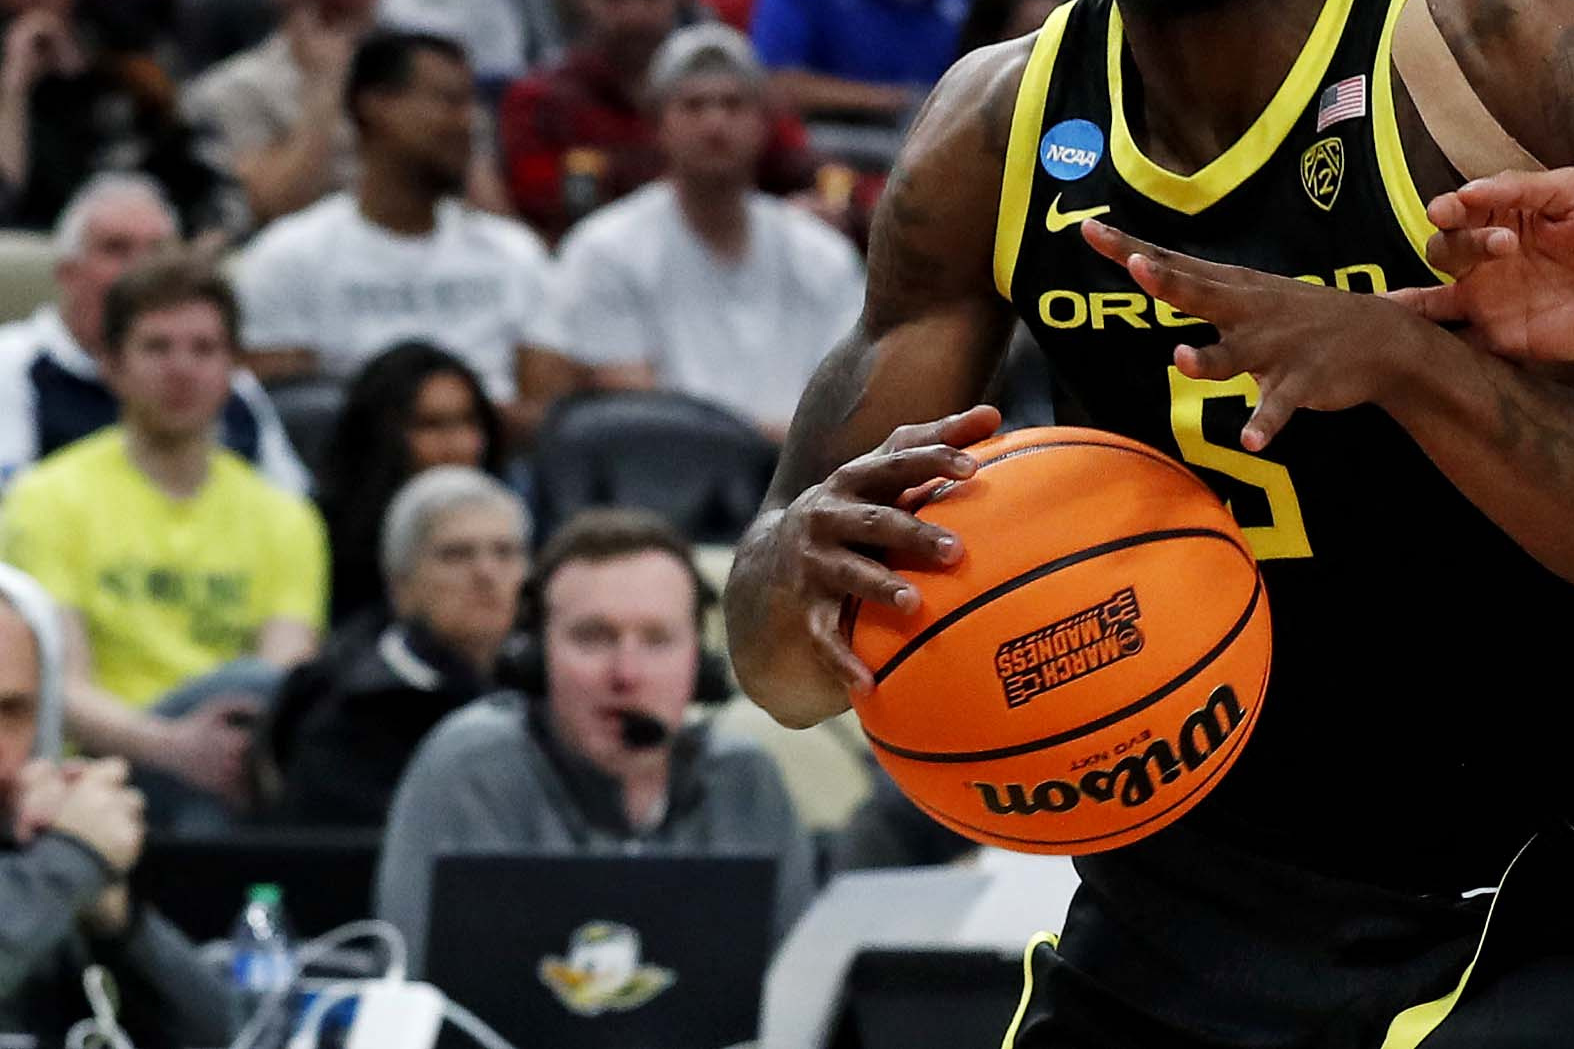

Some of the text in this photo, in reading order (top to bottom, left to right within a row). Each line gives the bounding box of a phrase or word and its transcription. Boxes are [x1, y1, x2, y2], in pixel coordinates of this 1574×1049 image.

[1046, 143, 1097, 168] NCAA
[1304, 141, 1341, 188] PAC
[1313, 167, 1335, 198] 12
[1038, 263, 1388, 330] OREN
[1168, 364, 1314, 561] 5
[997, 616, 1103, 679] MADNESS
[1041, 632, 1121, 688] MARCH
[974, 684, 1247, 815] Wilson
